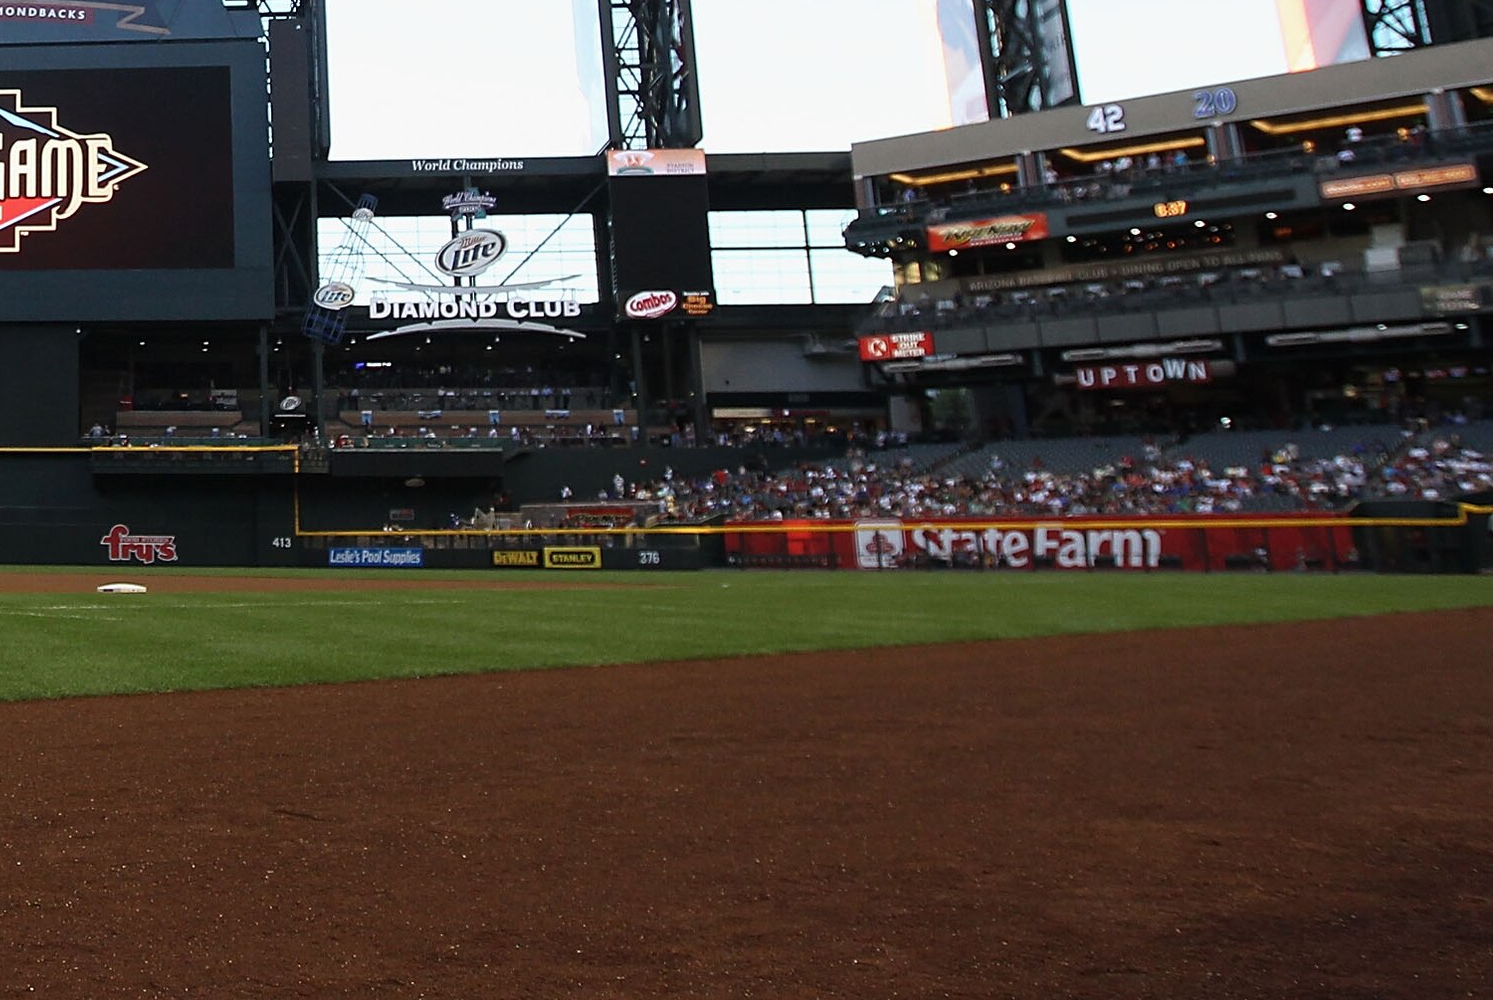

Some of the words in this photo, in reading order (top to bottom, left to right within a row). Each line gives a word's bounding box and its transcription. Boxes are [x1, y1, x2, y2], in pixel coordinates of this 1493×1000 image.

[1192, 87, 1237, 119] 20
[1086, 103, 1126, 134] 42
[412, 159, 451, 171] World
[453, 158, 524, 173] Champions
[451, 242, 497, 271] Lite
[369, 297, 498, 319] DIAMOND
[507, 297, 582, 318] CLUB
[630, 293, 673, 312] Combos
[891, 332, 926, 342] STRIKE
[899, 341, 919, 349] OUT
[892, 348, 926, 358] METER
[1077, 358, 1207, 387] UPTOWN
[101, 524, 177, 565] fry's
[272, 537, 292, 548] 413
[912, 522, 1030, 567] State
[1033, 521, 1162, 568] Farm
[330, 549, 360, 564] Leslie's
[361, 549, 382, 564] Pool
[382, 549, 421, 566] Supplies
[552, 553, 594, 564] STANLEY
[638, 551, 661, 565] 376
